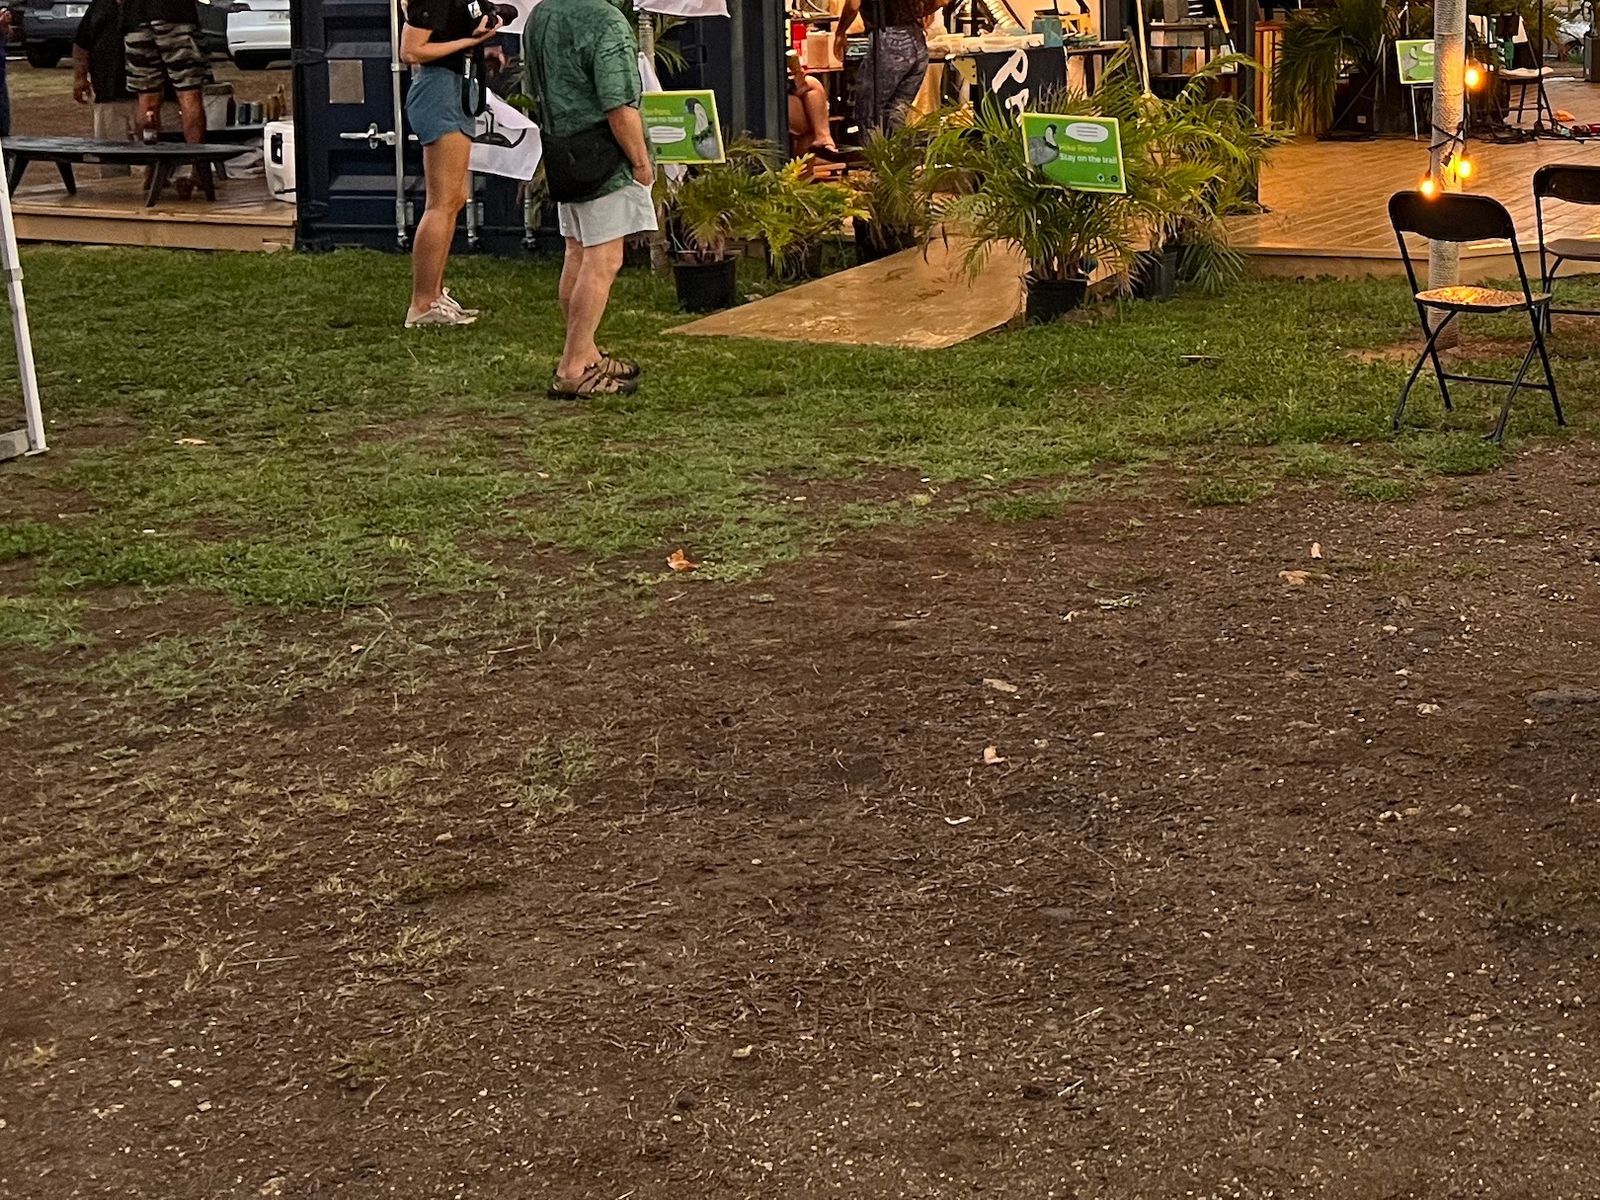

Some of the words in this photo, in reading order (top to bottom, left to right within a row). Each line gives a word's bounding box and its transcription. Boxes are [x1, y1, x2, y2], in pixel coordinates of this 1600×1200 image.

[1059, 152, 1076, 163] Stay
[1088, 155, 1101, 164] the
[1102, 156, 1118, 165] trail
